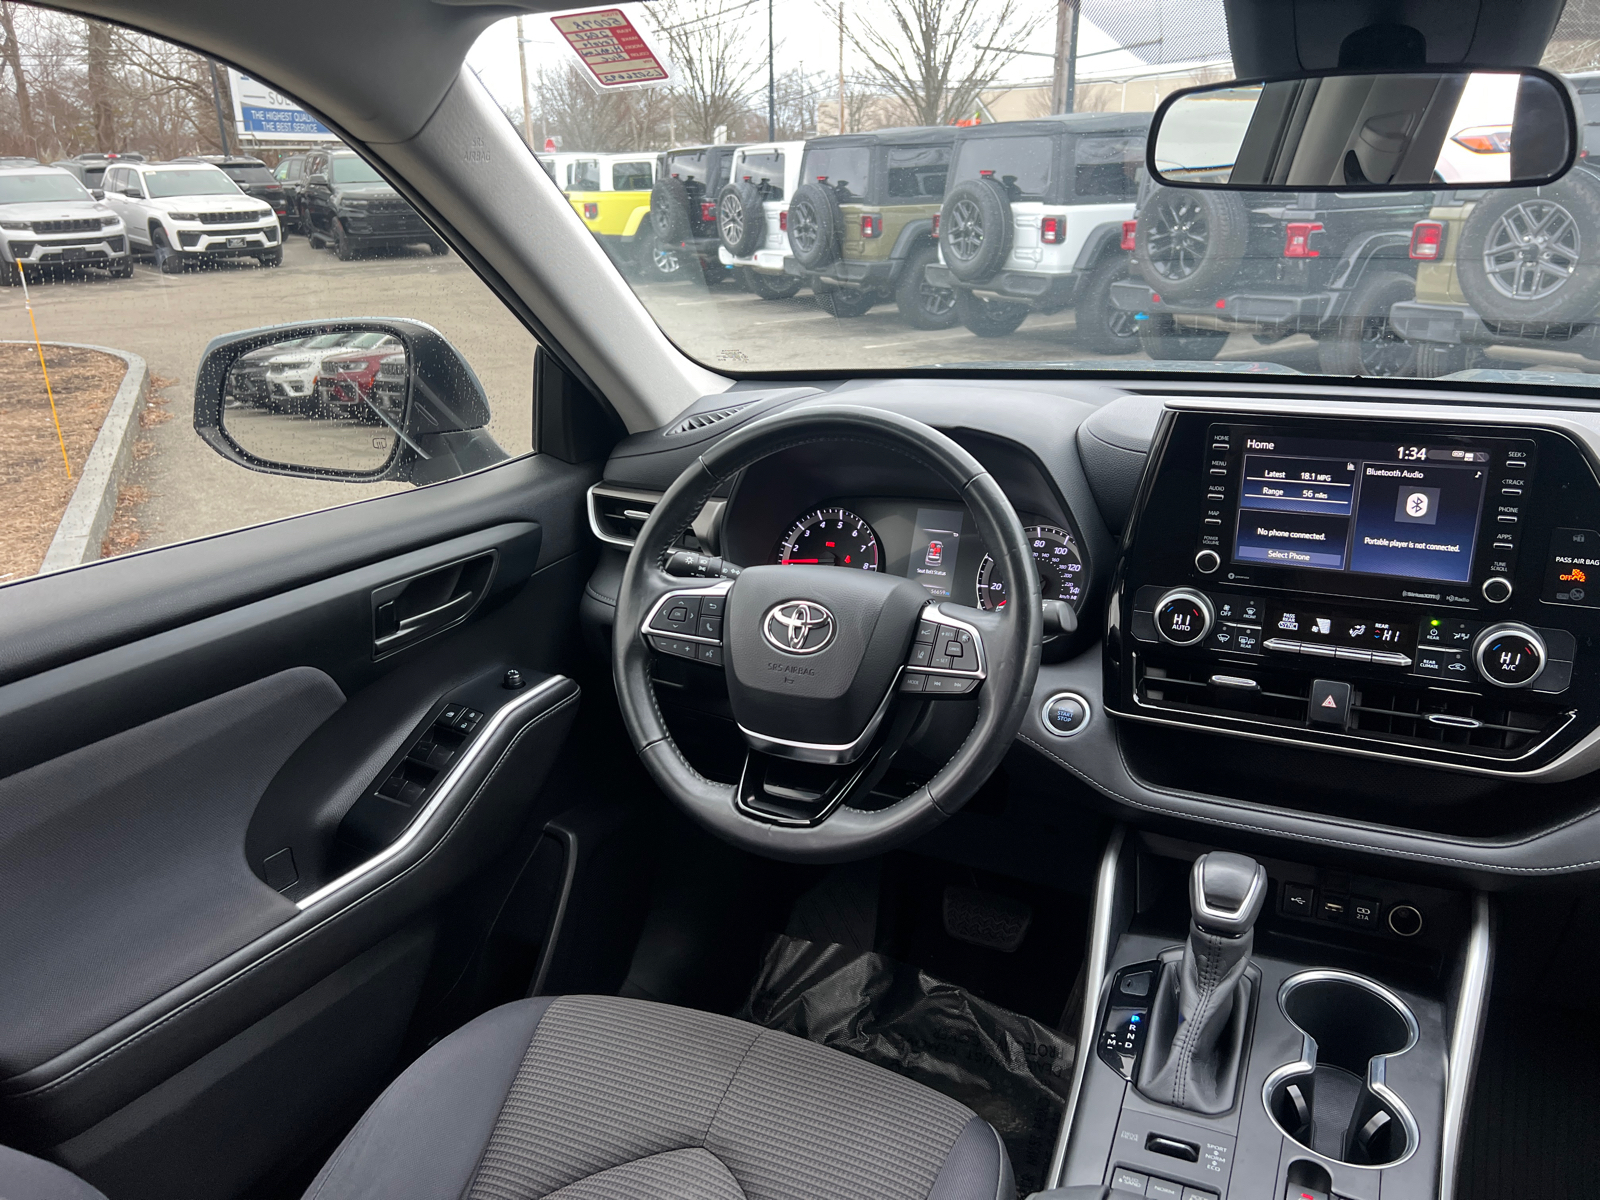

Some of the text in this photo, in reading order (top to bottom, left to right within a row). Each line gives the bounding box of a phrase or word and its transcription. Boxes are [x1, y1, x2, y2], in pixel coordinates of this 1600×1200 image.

[251, 110, 264, 120] THE
[266, 112, 293, 121] HIGHEST
[262, 122, 318, 132] THE BEST SERVICE
[1247, 439, 1275, 450] Home
[1397, 446, 1427, 460] 1:34
[1265, 470, 1286, 478] Latest
[1301, 472, 1316, 480] 18.1
[1366, 468, 1424, 478] Bluetooth Audio
[1263, 487, 1284, 496] Range
[1268, 529, 1289, 538] phone
[1290, 532, 1326, 540] connected.
[1364, 537, 1389, 546] Portable
[1390, 540, 1408, 549] player
[1426, 543, 1460, 552] connected.
[1054, 547, 1068, 555] 100
[1268, 551, 1310, 561] Select Phone
[1067, 564, 1081, 572] 120
[768, 662, 815, 676] SRS AIRBAG
[1131, 1014, 1140, 1023] P
[966, 1050, 1000, 1067] UST
[1207, 1143, 1227, 1153] SPORT
[1205, 1153, 1226, 1163] NORM
[1154, 1186, 1175, 1194] NORM
